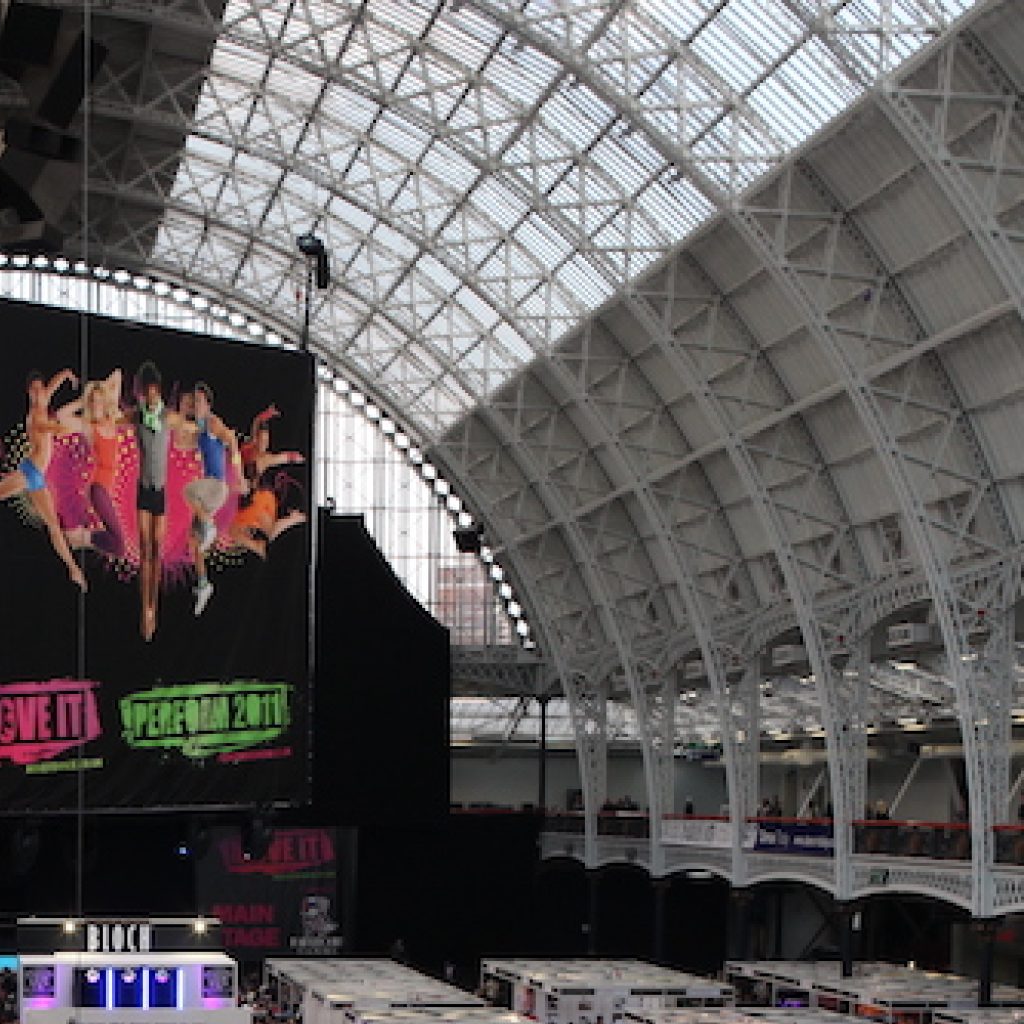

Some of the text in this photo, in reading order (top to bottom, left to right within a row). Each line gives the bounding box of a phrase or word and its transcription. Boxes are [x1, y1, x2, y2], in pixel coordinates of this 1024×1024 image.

[55, 693, 84, 740] IT
[233, 691, 282, 729] 2011
[87, 924, 150, 951] BLOCH
[222, 928, 280, 947] TAGE
